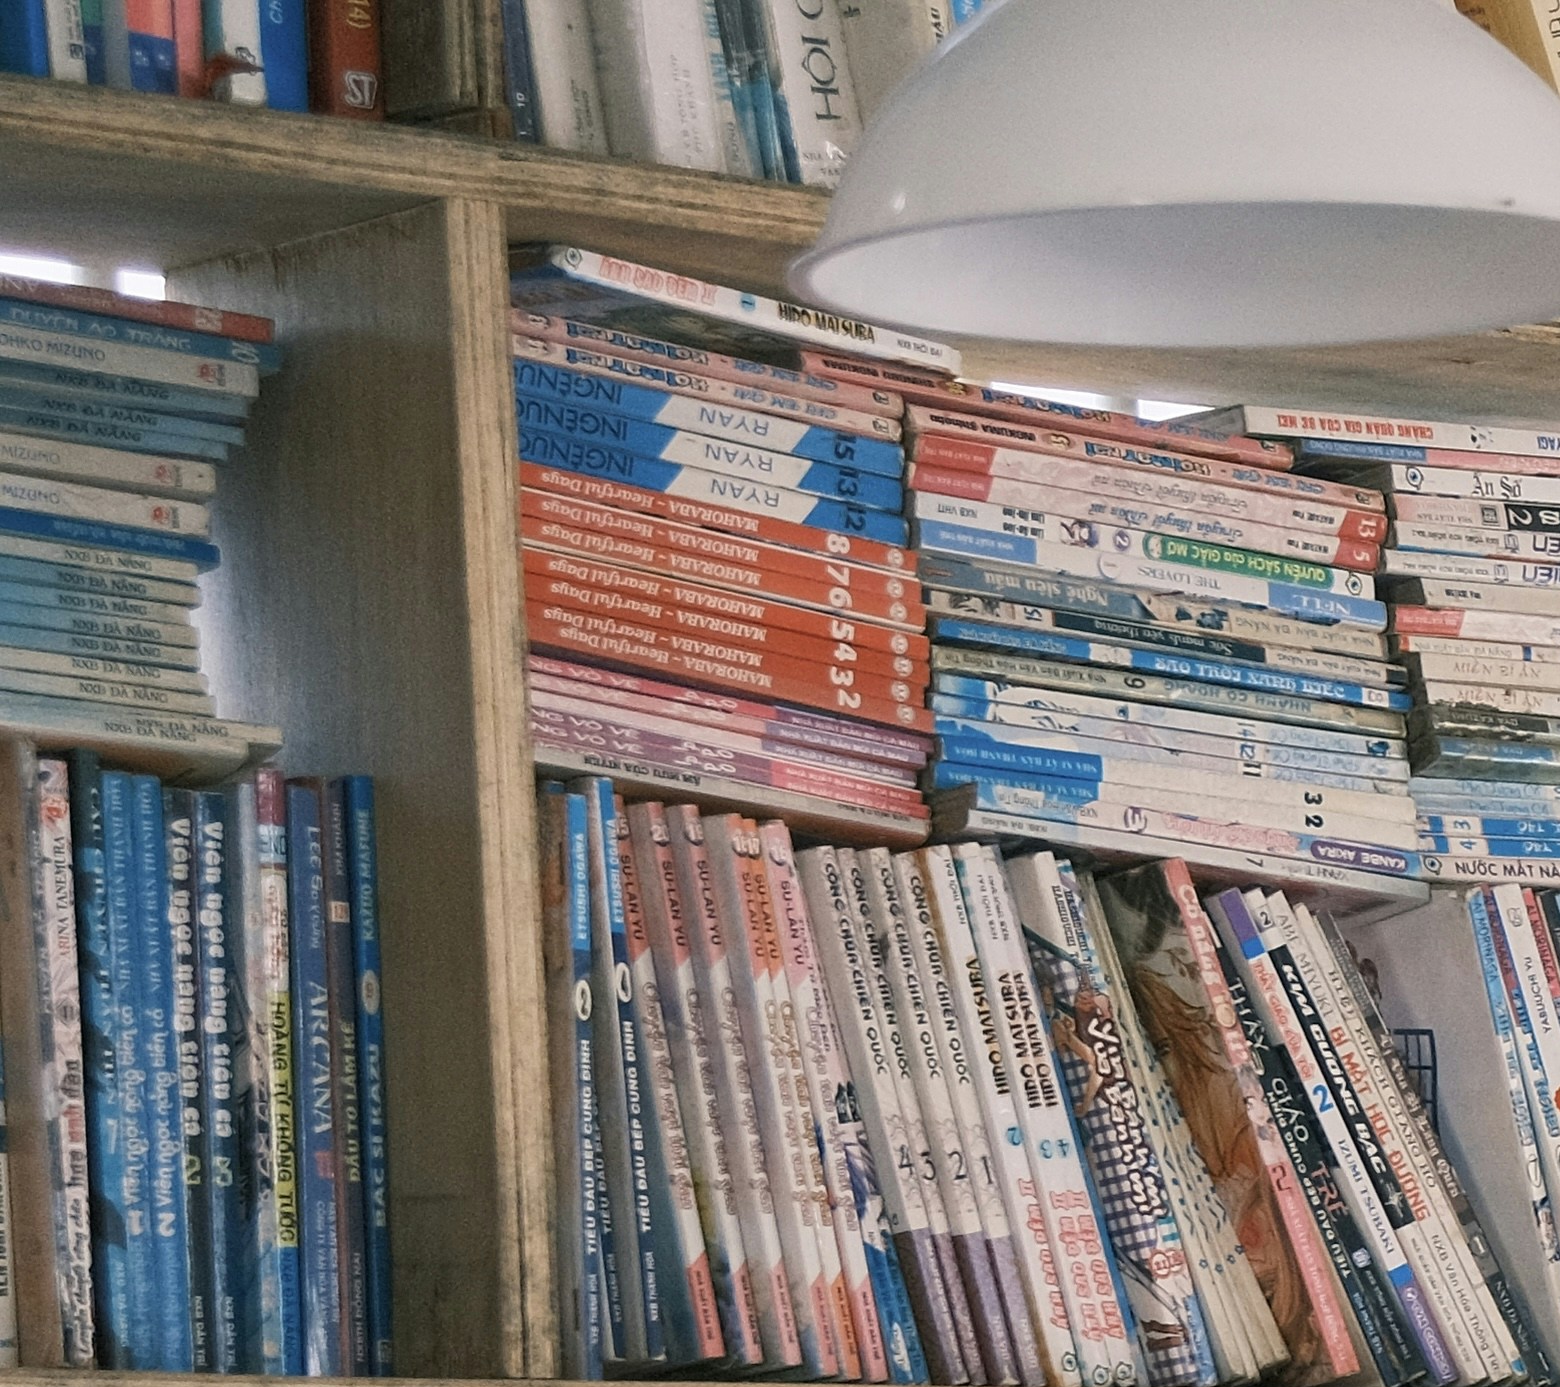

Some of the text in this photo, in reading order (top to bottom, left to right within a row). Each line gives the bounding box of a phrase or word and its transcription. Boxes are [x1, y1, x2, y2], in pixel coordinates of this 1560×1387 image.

[700, 407, 770, 436] RYAN
[541, 471, 759, 533] MAHORABA Heartful Days
